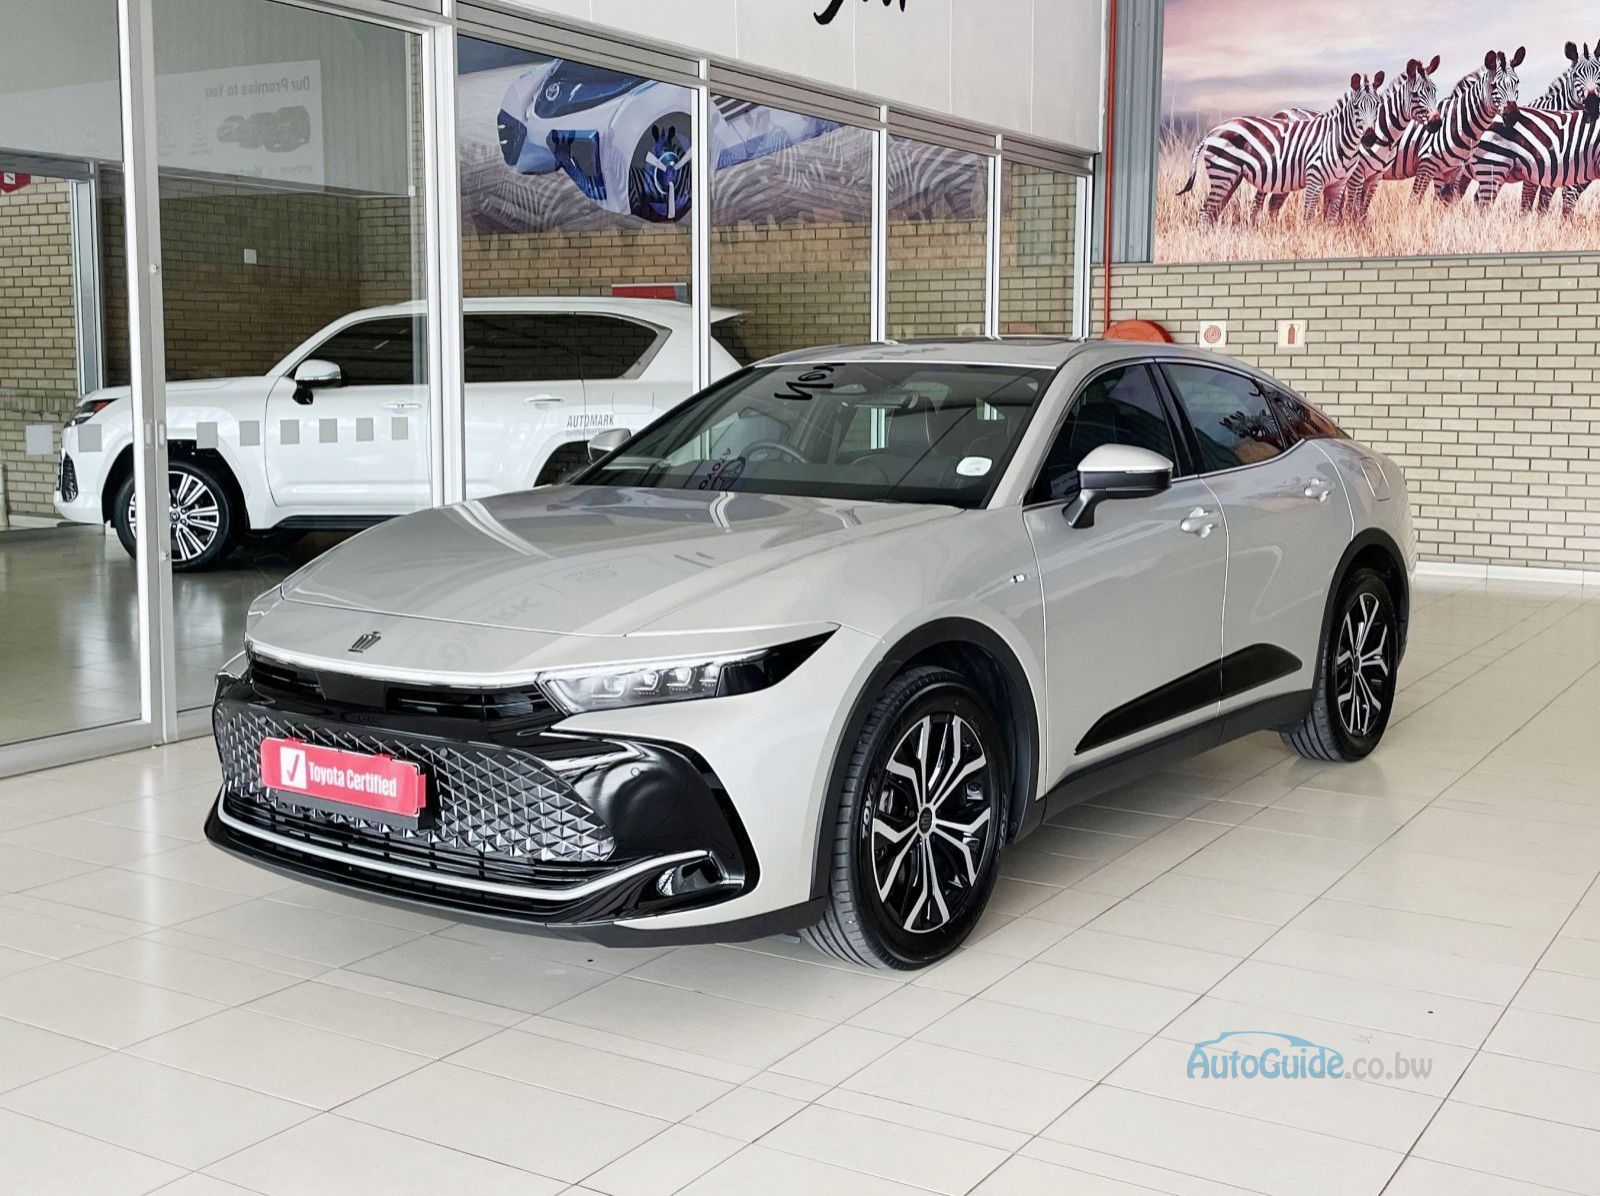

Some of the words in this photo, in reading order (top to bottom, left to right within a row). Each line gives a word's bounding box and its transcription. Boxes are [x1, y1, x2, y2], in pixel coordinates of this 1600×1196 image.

[566, 414, 615, 428] AUTOMARK
[308, 761, 345, 788] Toyota
[346, 770, 398, 798] Certified
